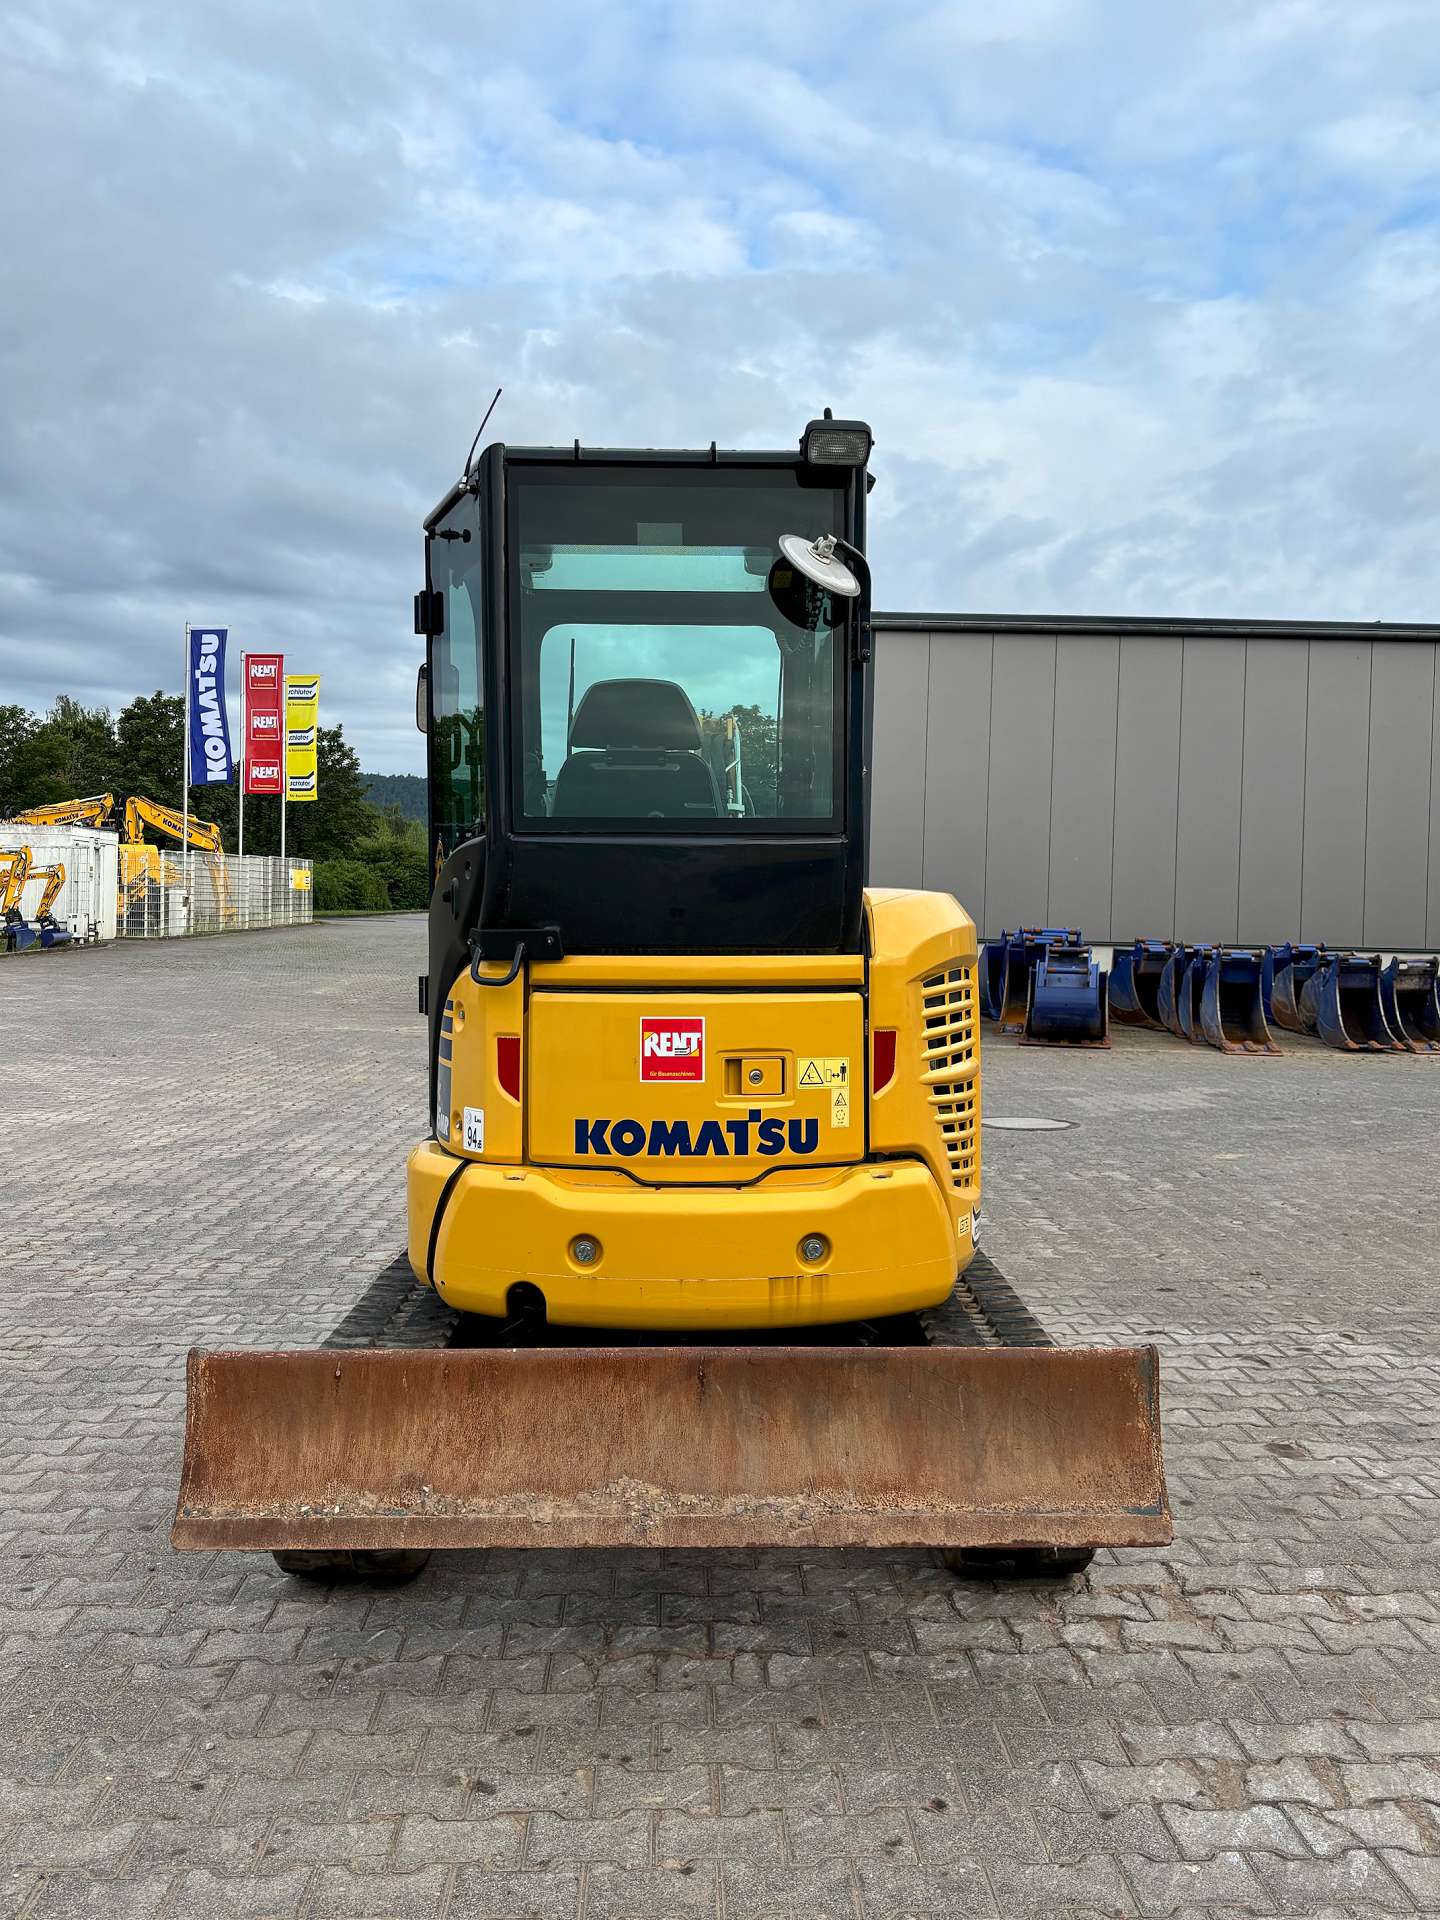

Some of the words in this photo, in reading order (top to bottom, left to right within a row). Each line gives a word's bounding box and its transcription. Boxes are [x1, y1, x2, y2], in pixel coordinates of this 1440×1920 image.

[250, 664, 277, 678] RENT
[195, 634, 228, 781] KOMATSU
[253, 715, 278, 729] RENT
[251, 766, 279, 779] RENT
[54, 812, 79, 824] KOMATSU
[644, 1032, 702, 1057] RENT
[467, 1126, 477, 1148] 94
[574, 1109, 819, 1157] KOMATSU
